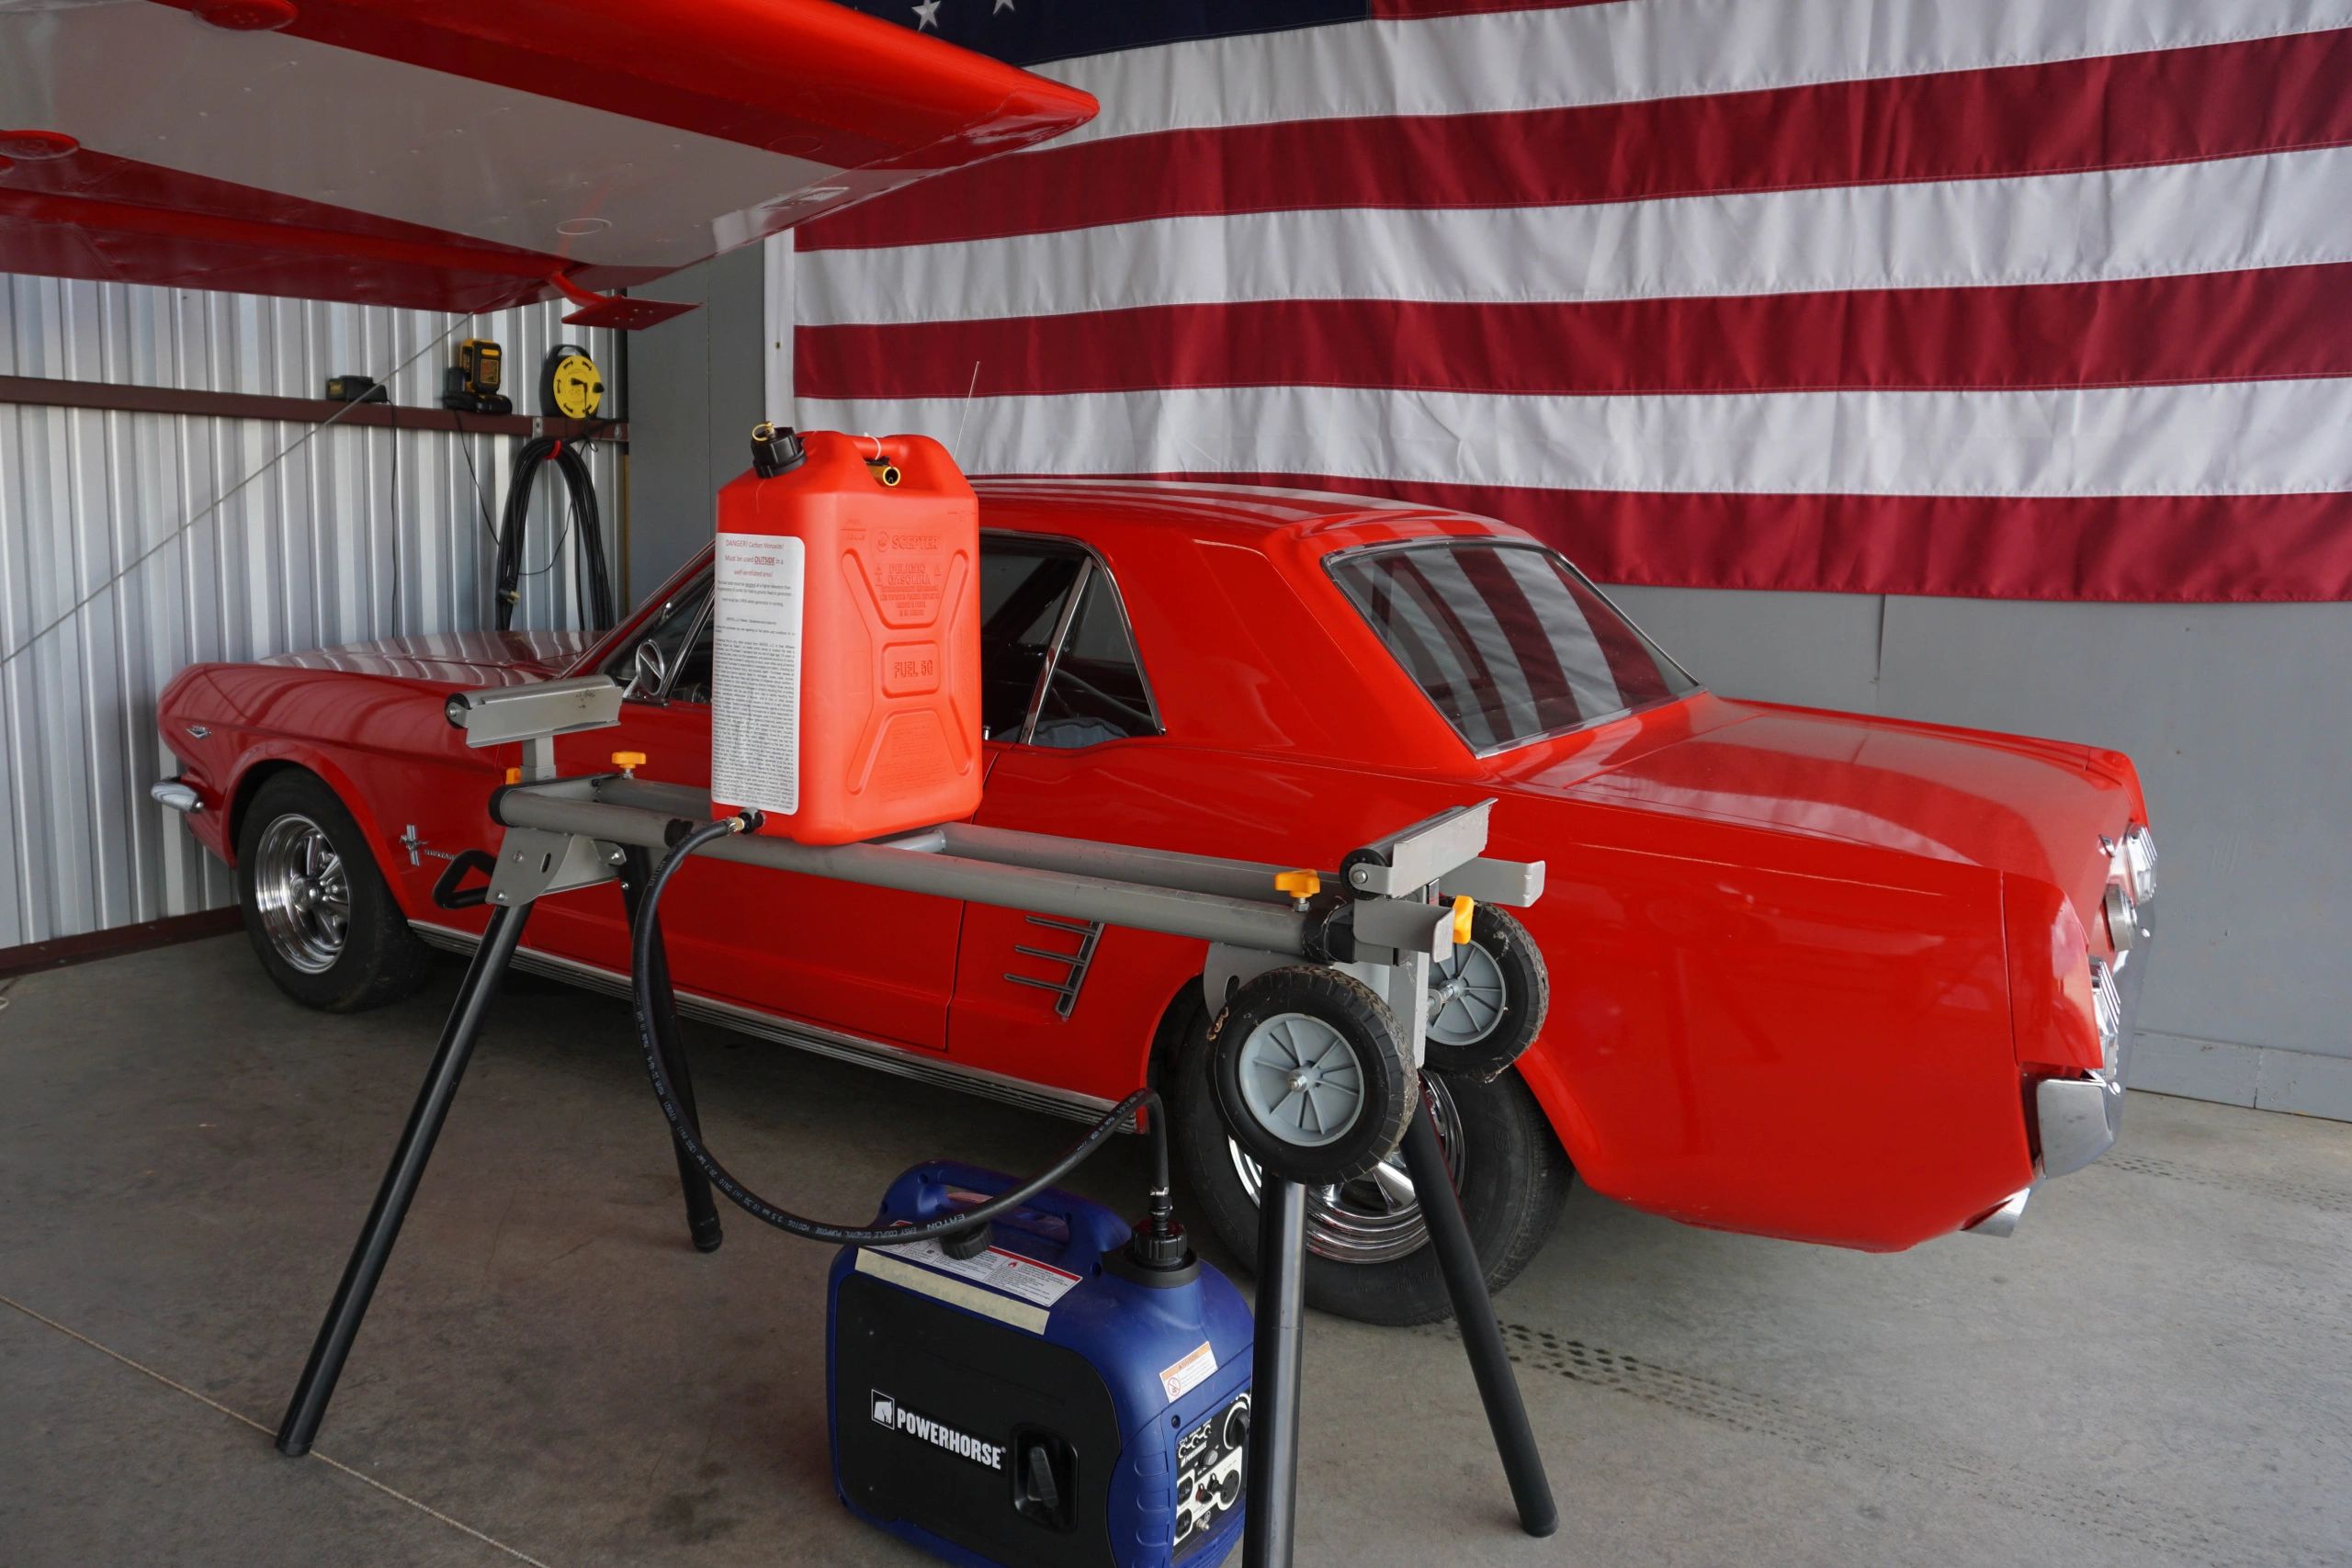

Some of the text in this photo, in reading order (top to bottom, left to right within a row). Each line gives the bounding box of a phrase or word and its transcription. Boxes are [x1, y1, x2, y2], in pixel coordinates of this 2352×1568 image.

[725, 539, 748, 548] DANGER!
[754, 556, 775, 565] OUTSIDE
[894, 660, 919, 679] FUEL
[926, 1213, 966, 1231] EATON
[814, 1226, 842, 1237] PURPOSE
[899, 1226, 917, 1235] EASY
[898, 1407, 1001, 1471] POWERHORSE
